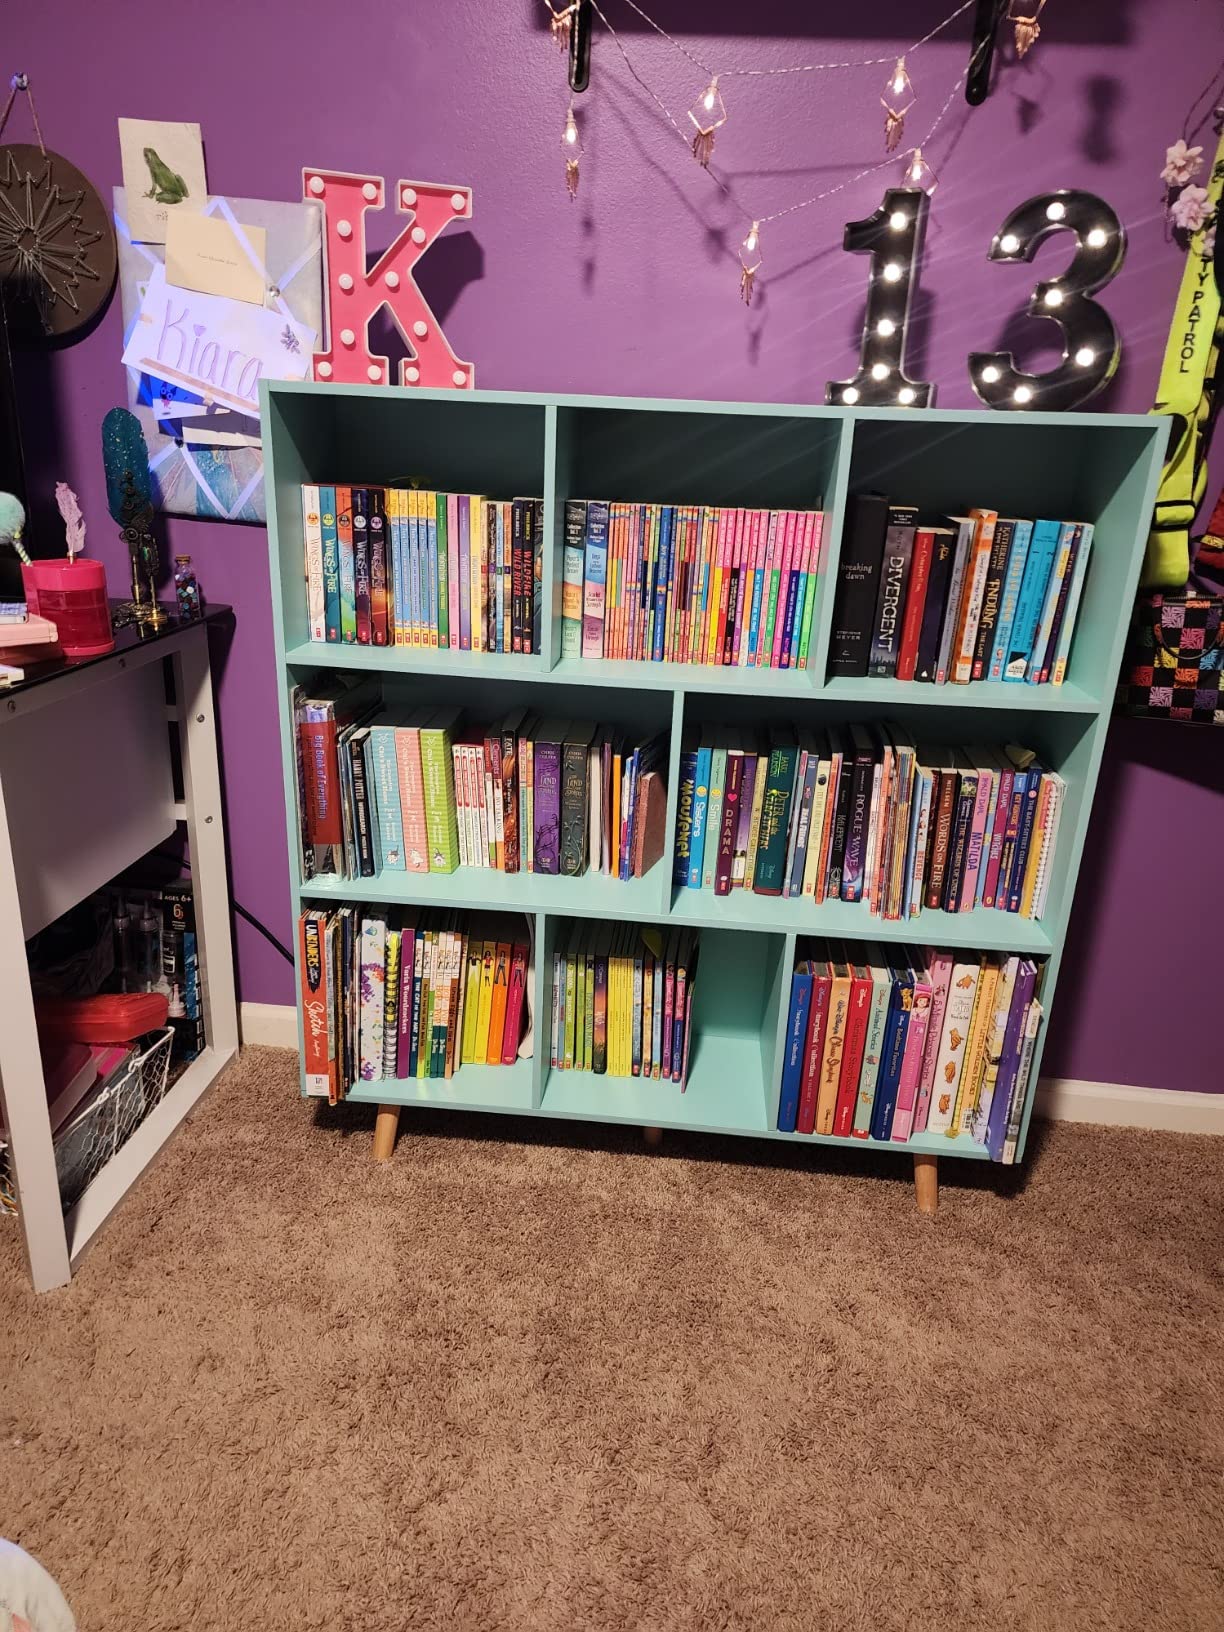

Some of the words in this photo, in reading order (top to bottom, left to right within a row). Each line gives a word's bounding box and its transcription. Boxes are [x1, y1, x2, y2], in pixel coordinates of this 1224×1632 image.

[301, 167, 475, 388] K
[1180, 291, 1204, 373] PATROL
[157, 299, 263, 400] Kiara
[311, 537, 321, 566] WINGS
[325, 539, 335, 567] WINGS
[356, 541, 367, 569] WINGS
[373, 541, 383, 570] WINGS
[514, 548, 522, 571] WILD
[997, 527, 1011, 570] KATHERINE
[312, 572, 322, 592] FIRE
[327, 573, 337, 593] FIRE
[343, 574, 353, 594] FIRE
[358, 575, 368, 595] FIRE
[514, 572, 522, 596] RIVER
[523, 551, 531, 596] WILDFIRE
[845, 573, 865, 581] dawn
[878, 557, 904, 653] DIVERGENT
[981, 579, 1000, 628] ENDLING
[977, 641, 985, 657] LAST
[315, 735, 324, 747] Big
[316, 750, 325, 769] Book
[353, 760, 363, 777] HARRY
[492, 744, 500, 774] Clements
[770, 750, 779, 777] PEARSON
[781, 756, 789, 773] BARRY
[317, 770, 326, 779] of
[1003, 774, 1012, 791] ROALD
[317, 780, 327, 818] Everything
[354, 779, 365, 800] POTTER
[944, 780, 952, 807] NIELSEN
[979, 777, 990, 797] ROALD
[1014, 794, 1022, 804] KEY
[977, 799, 986, 816] DAHL
[1000, 793, 1008, 808] DAHL
[358, 802, 366, 834] WORDSEARCH
[693, 801, 705, 837] Sisters
[708, 804, 720, 830] Smile
[853, 794, 866, 833] ROGUE
[1011, 804, 1021, 825] HUNTERS
[721, 809, 734, 854] DRAMA
[936, 813, 950, 852] WORDS
[1020, 811, 1033, 850] BABY-SITTERS
[850, 836, 862, 867] WAVE
[954, 839, 965, 867] WIZARDS
[967, 832, 982, 870] MATILDA
[990, 833, 1002, 859] WITCHES
[1018, 850, 1026, 864] CLUB
[915, 850, 925, 880] REVENGE
[932, 864, 944, 888] FIRE
[952, 868, 959, 878] OF
[950, 879, 959, 897] ONCE
[306, 924, 319, 967] UNBINDERS
[403, 965, 411, 984] Varia
[304, 1000, 328, 1037] Sketch
[794, 1009, 803, 1036] Storybook
[812, 1011, 824, 1042] Storybook
[872, 1008, 884, 1030] Animal
[897, 1015, 906, 1026] Disney
[849, 1018, 865, 1055] Christmas
[869, 1031, 880, 1050] Stories
[893, 1027, 904, 1050] Bedtime
[925, 1030, 938, 1058] Princess
[977, 1028, 987, 1049] LITTLE
[790, 1039, 800, 1066] Collection
[808, 1045, 820, 1077] Collection
[1025, 1041, 1033, 1058] WHERE
[890, 1052, 900, 1076] Favorites
[922, 1059, 934, 1080] Stories
[974, 1050, 984, 1074] GOLDEN
[844, 1056, 858, 1094] Storybook
[969, 1076, 979, 1095] BOOKS
[1020, 1069, 1028, 1081] WILD
[1018, 1081, 1026, 1099] THINGS
